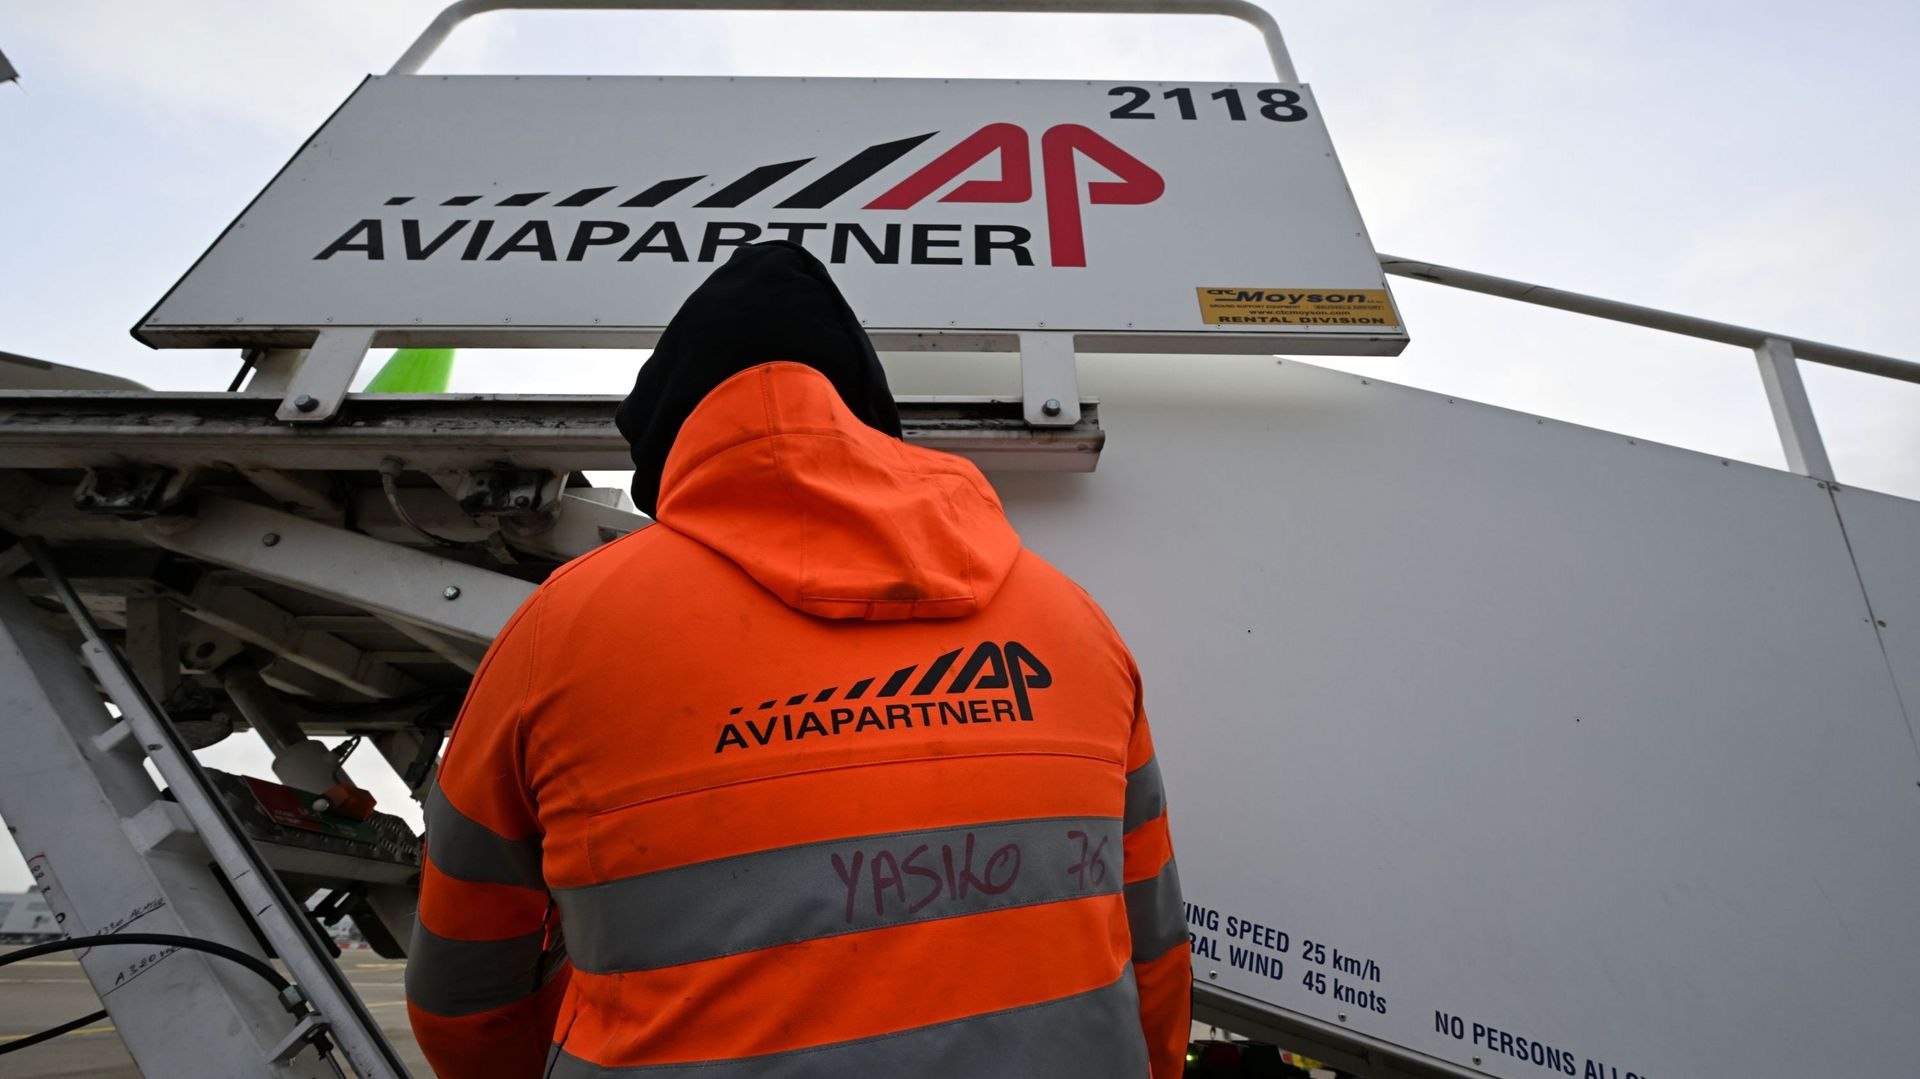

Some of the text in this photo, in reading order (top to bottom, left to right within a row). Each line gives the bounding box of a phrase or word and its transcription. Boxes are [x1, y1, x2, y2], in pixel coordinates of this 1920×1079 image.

[1107, 86, 1308, 122] 2118
[312, 218, 1035, 266] AVIAPARTNER
[1218, 316, 1293, 324] RENTAL
[1236, 291, 1366, 304] Moyson
[715, 699, 1016, 753] AVIAPARTNER
[1183, 902, 1380, 982] ING SPEED 25 km/h
[1229, 945, 1283, 981] WIND
[1302, 970, 1327, 995] 45
[1334, 978, 1387, 1014] knots
[1435, 1010, 1465, 1040] NO
[1473, 1022, 1576, 1076] PERSONS
